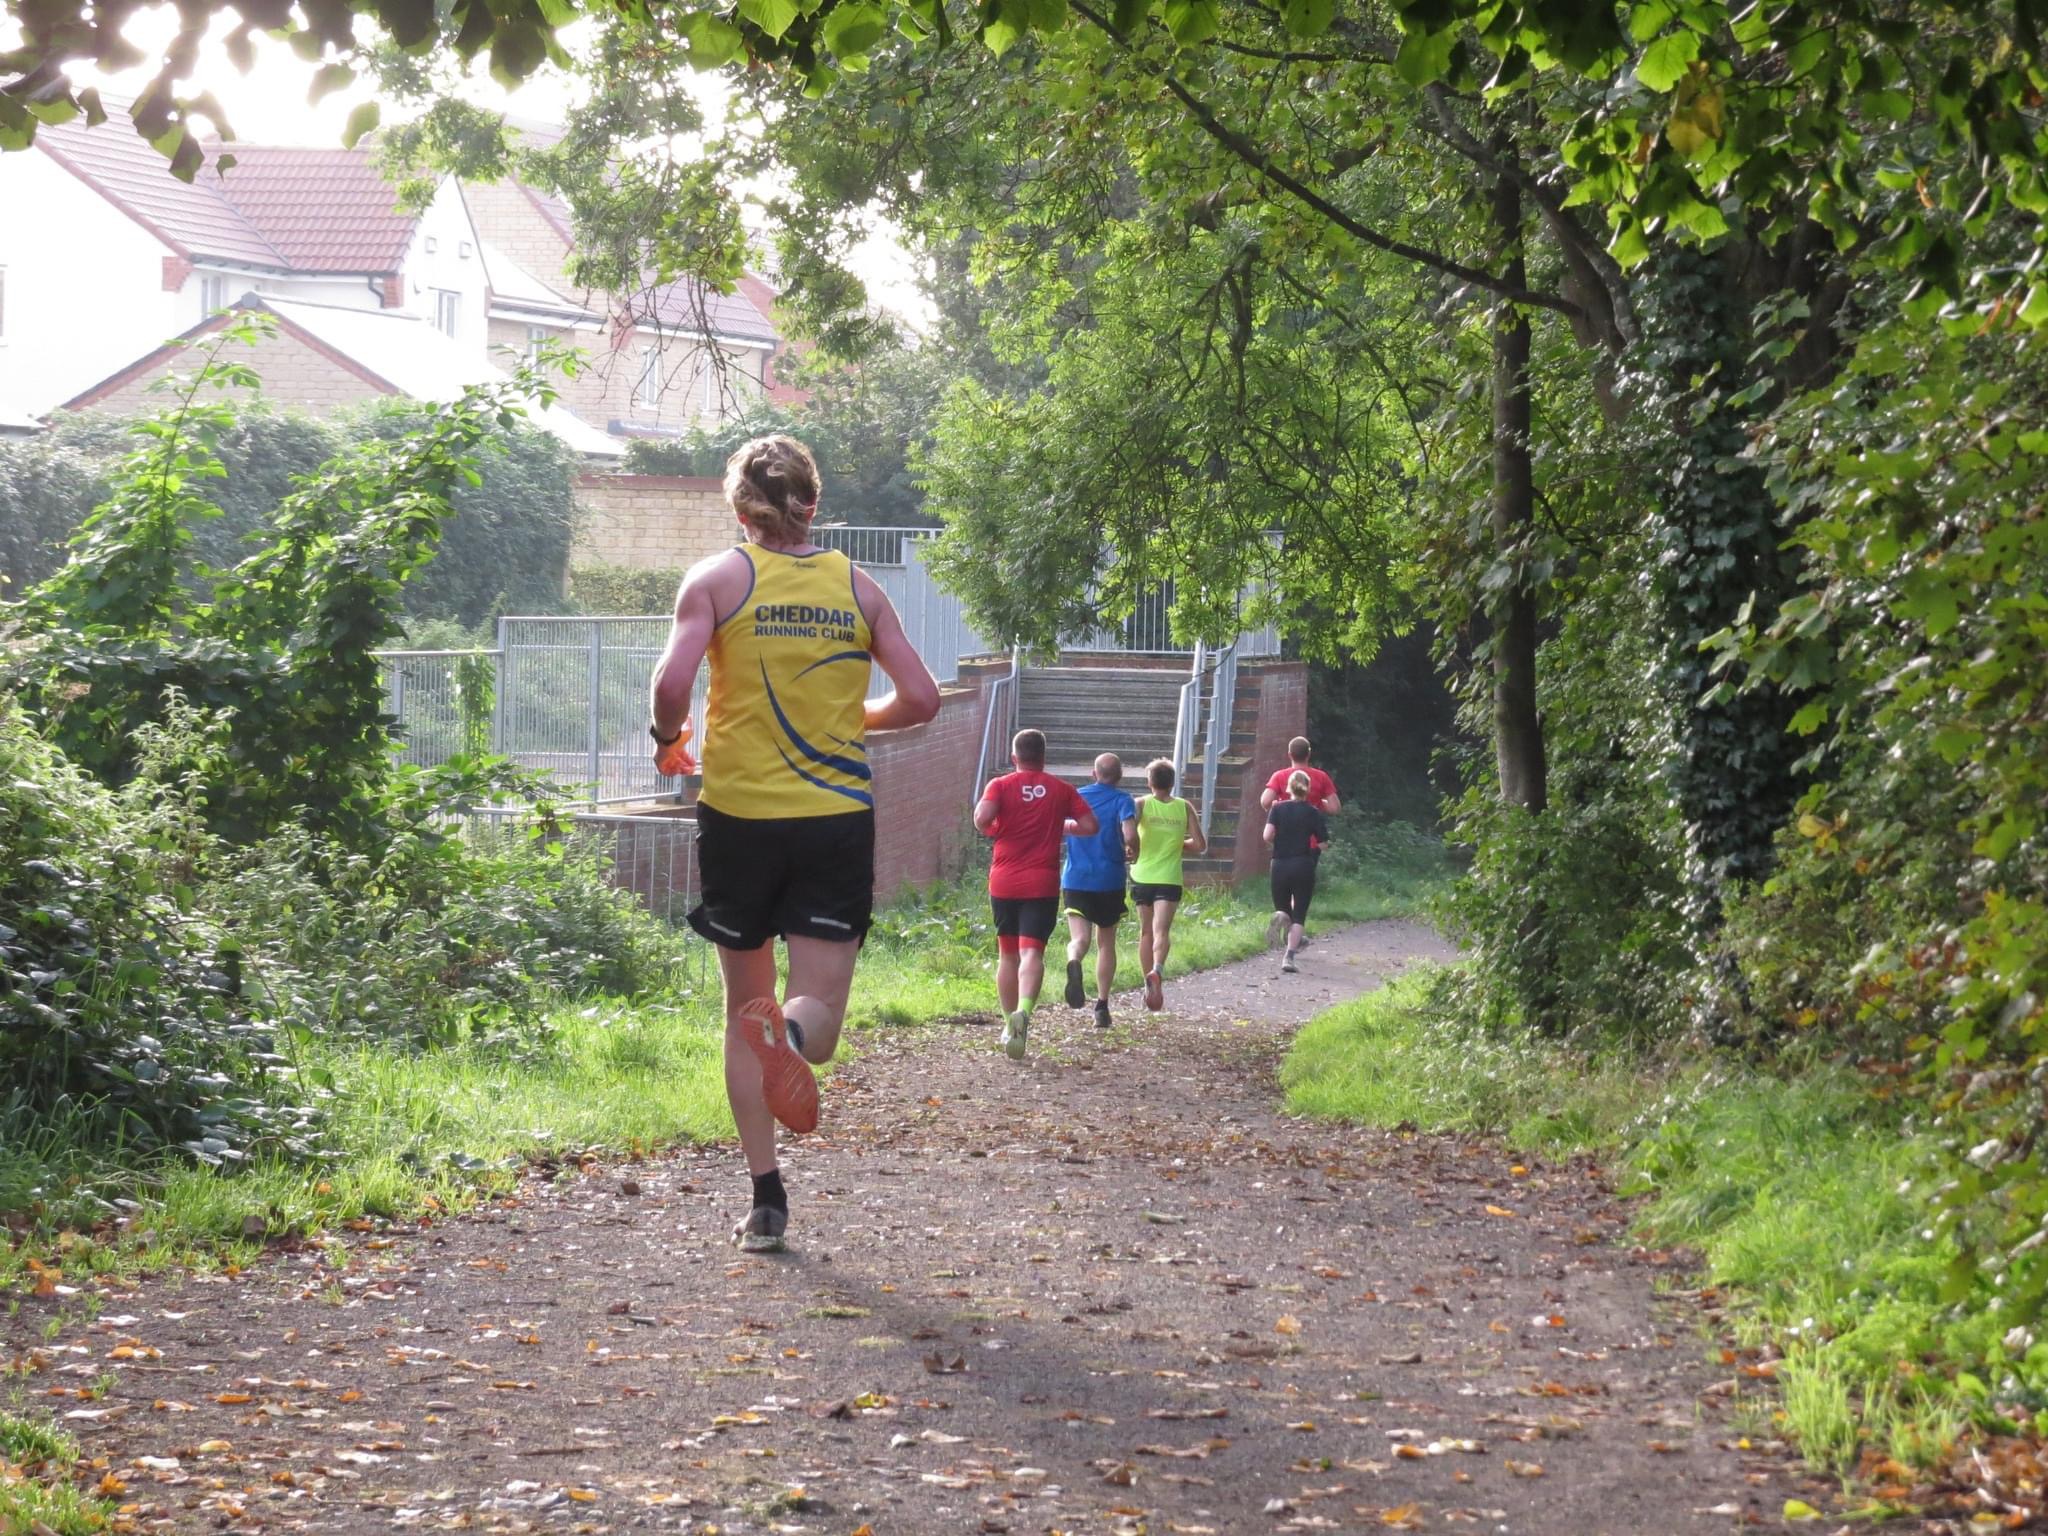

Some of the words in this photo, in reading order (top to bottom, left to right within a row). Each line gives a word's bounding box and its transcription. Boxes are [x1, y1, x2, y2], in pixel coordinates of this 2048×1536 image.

[755, 605, 856, 628] CHEDDAR
[755, 625, 817, 638] RUNNING
[821, 627, 855, 643] CLUB
[1022, 785, 1046, 801] 50
